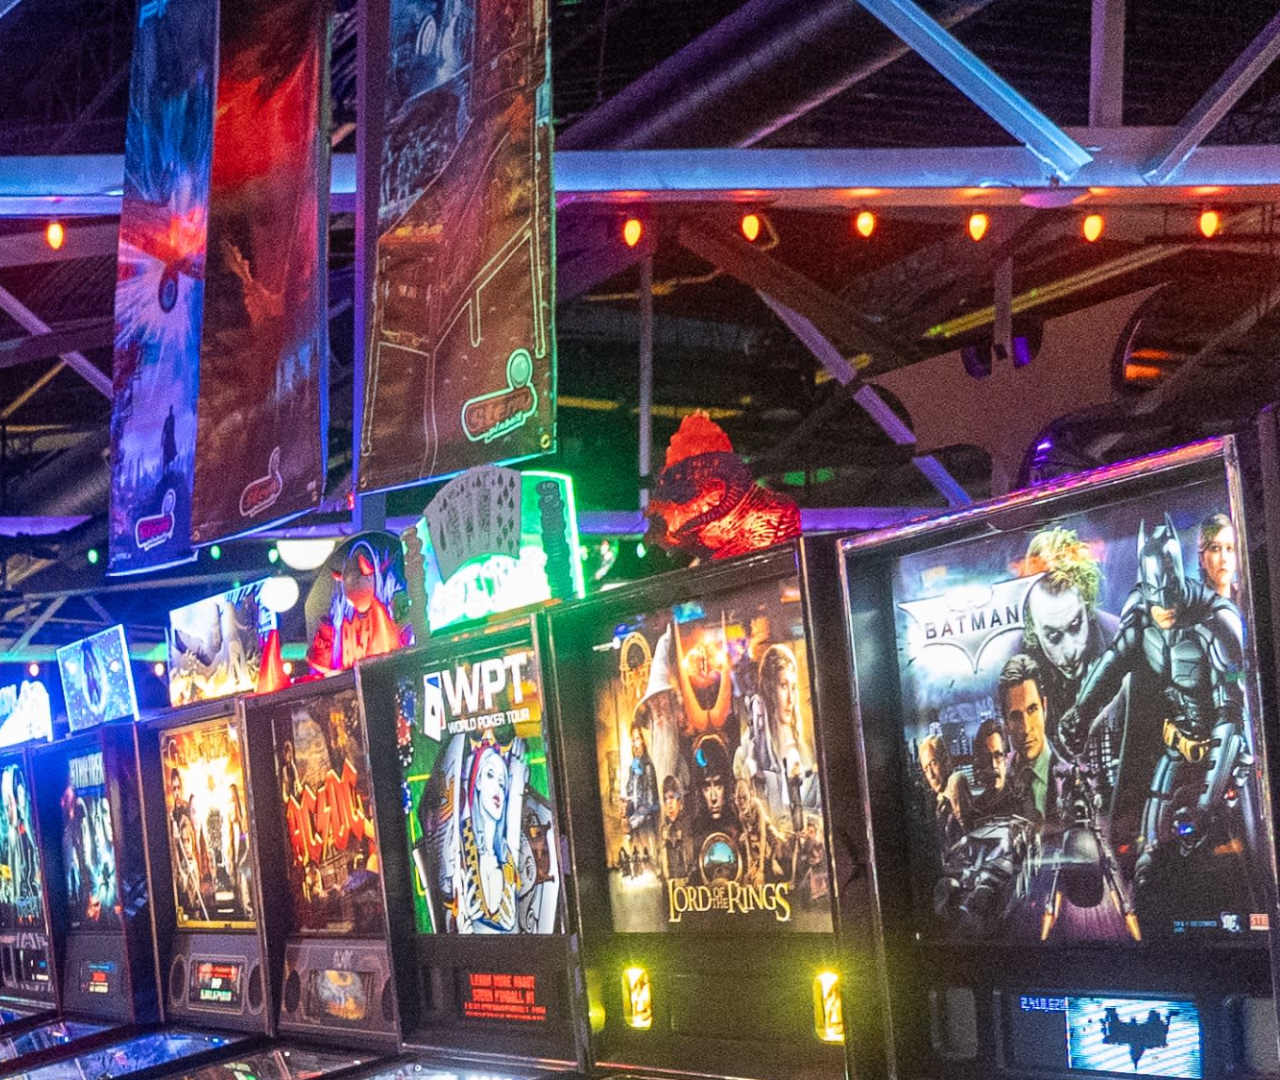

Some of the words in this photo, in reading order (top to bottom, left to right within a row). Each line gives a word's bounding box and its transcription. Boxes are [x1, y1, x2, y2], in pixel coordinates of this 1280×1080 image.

[925, 604, 1020, 641] BATMAN
[442, 651, 527, 717] WPT
[448, 718, 476, 734] WORLD
[477, 712, 505, 729] POKER
[506, 708, 530, 724] TOUR
[669, 878, 712, 922] LORD
[712, 887, 725, 897] OF
[712, 898, 729, 910] THE
[727, 881, 792, 923] RINGS
